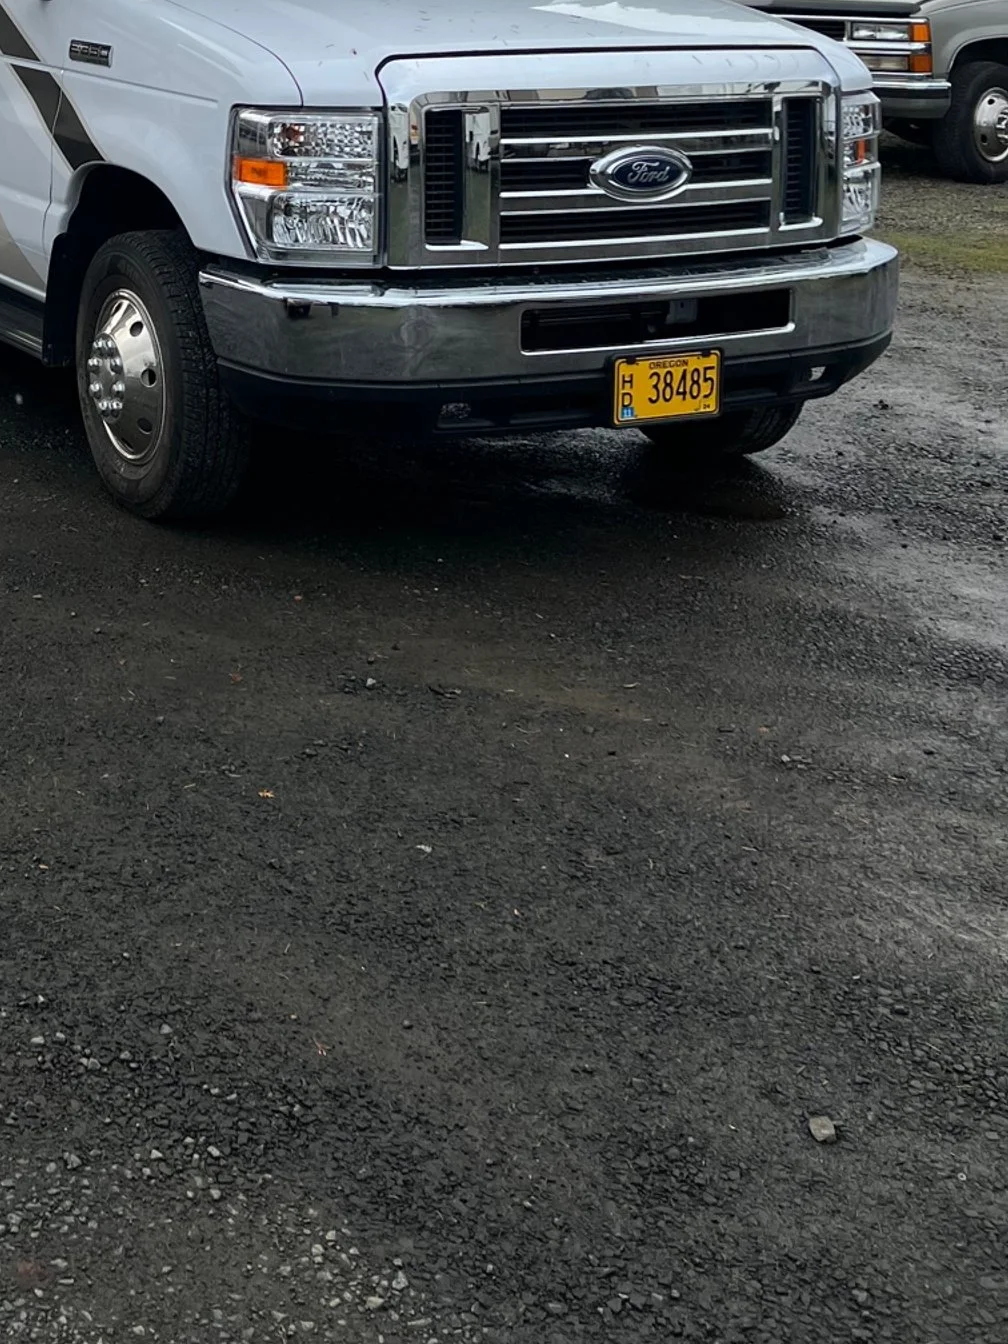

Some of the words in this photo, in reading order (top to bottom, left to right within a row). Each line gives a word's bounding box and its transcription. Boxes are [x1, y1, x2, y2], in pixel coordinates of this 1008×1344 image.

[627, 161, 671, 184] Ford
[649, 359, 689, 370] OREGON
[648, 365, 715, 405] 38485
